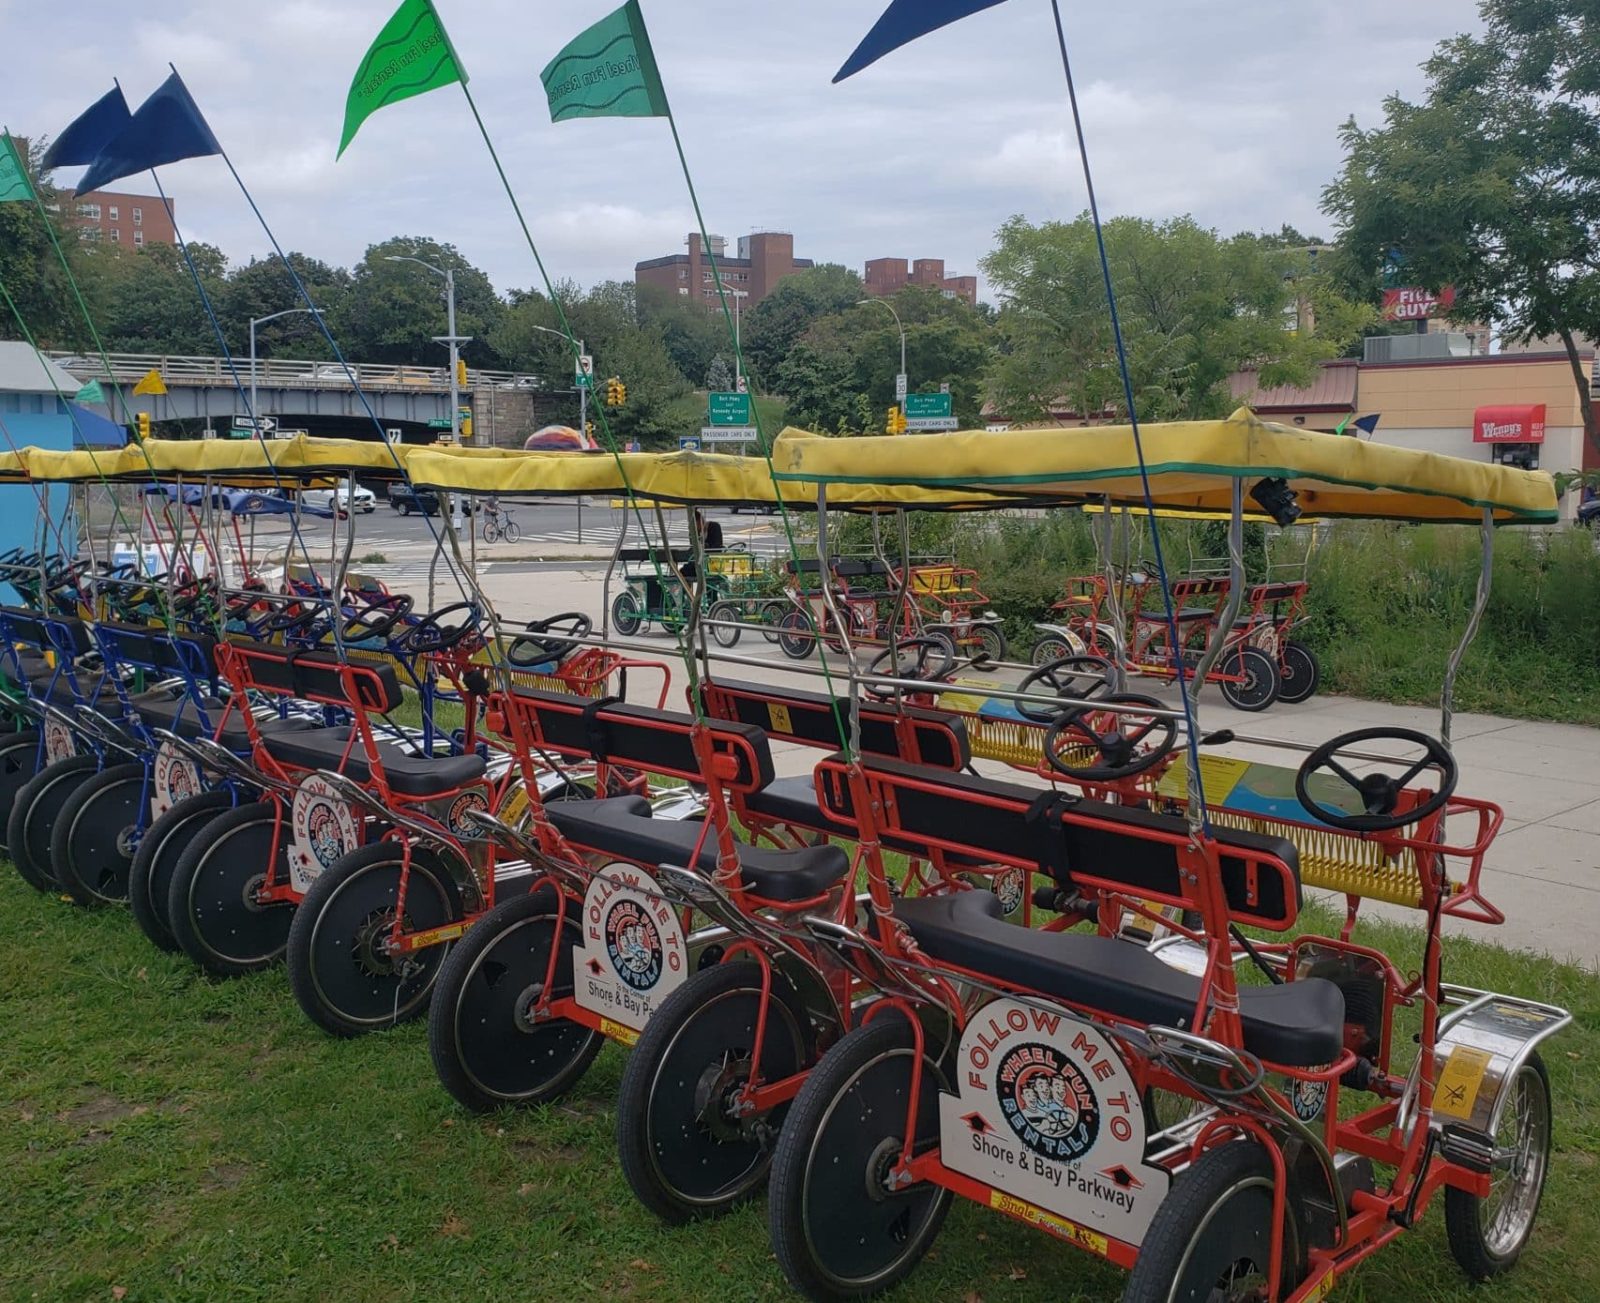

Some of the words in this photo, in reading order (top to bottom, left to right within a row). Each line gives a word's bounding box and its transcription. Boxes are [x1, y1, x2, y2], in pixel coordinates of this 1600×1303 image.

[589, 871, 640, 941] FOLLOW
[666, 931, 681, 972] TO
[608, 902, 640, 932] WHEEL
[588, 981, 614, 1003] Shore
[615, 991, 622, 1006] &
[624, 994, 641, 1017] Bay
[968, 1007, 1062, 1091] FOLLOW
[1071, 1031, 1116, 1083] ME
[1106, 1091, 1132, 1142] TO
[1001, 1047, 1058, 1083] WHEEL
[1061, 1062, 1093, 1110] FUN
[1002, 1097, 1090, 1156] RENTALS
[972, 1133, 1015, 1164] Shore
[1018, 1151, 1030, 1171] &
[1034, 1157, 1063, 1187] Bay
[1067, 1169, 1136, 1214] Parkway
[998, 1195, 1035, 1220] Single
